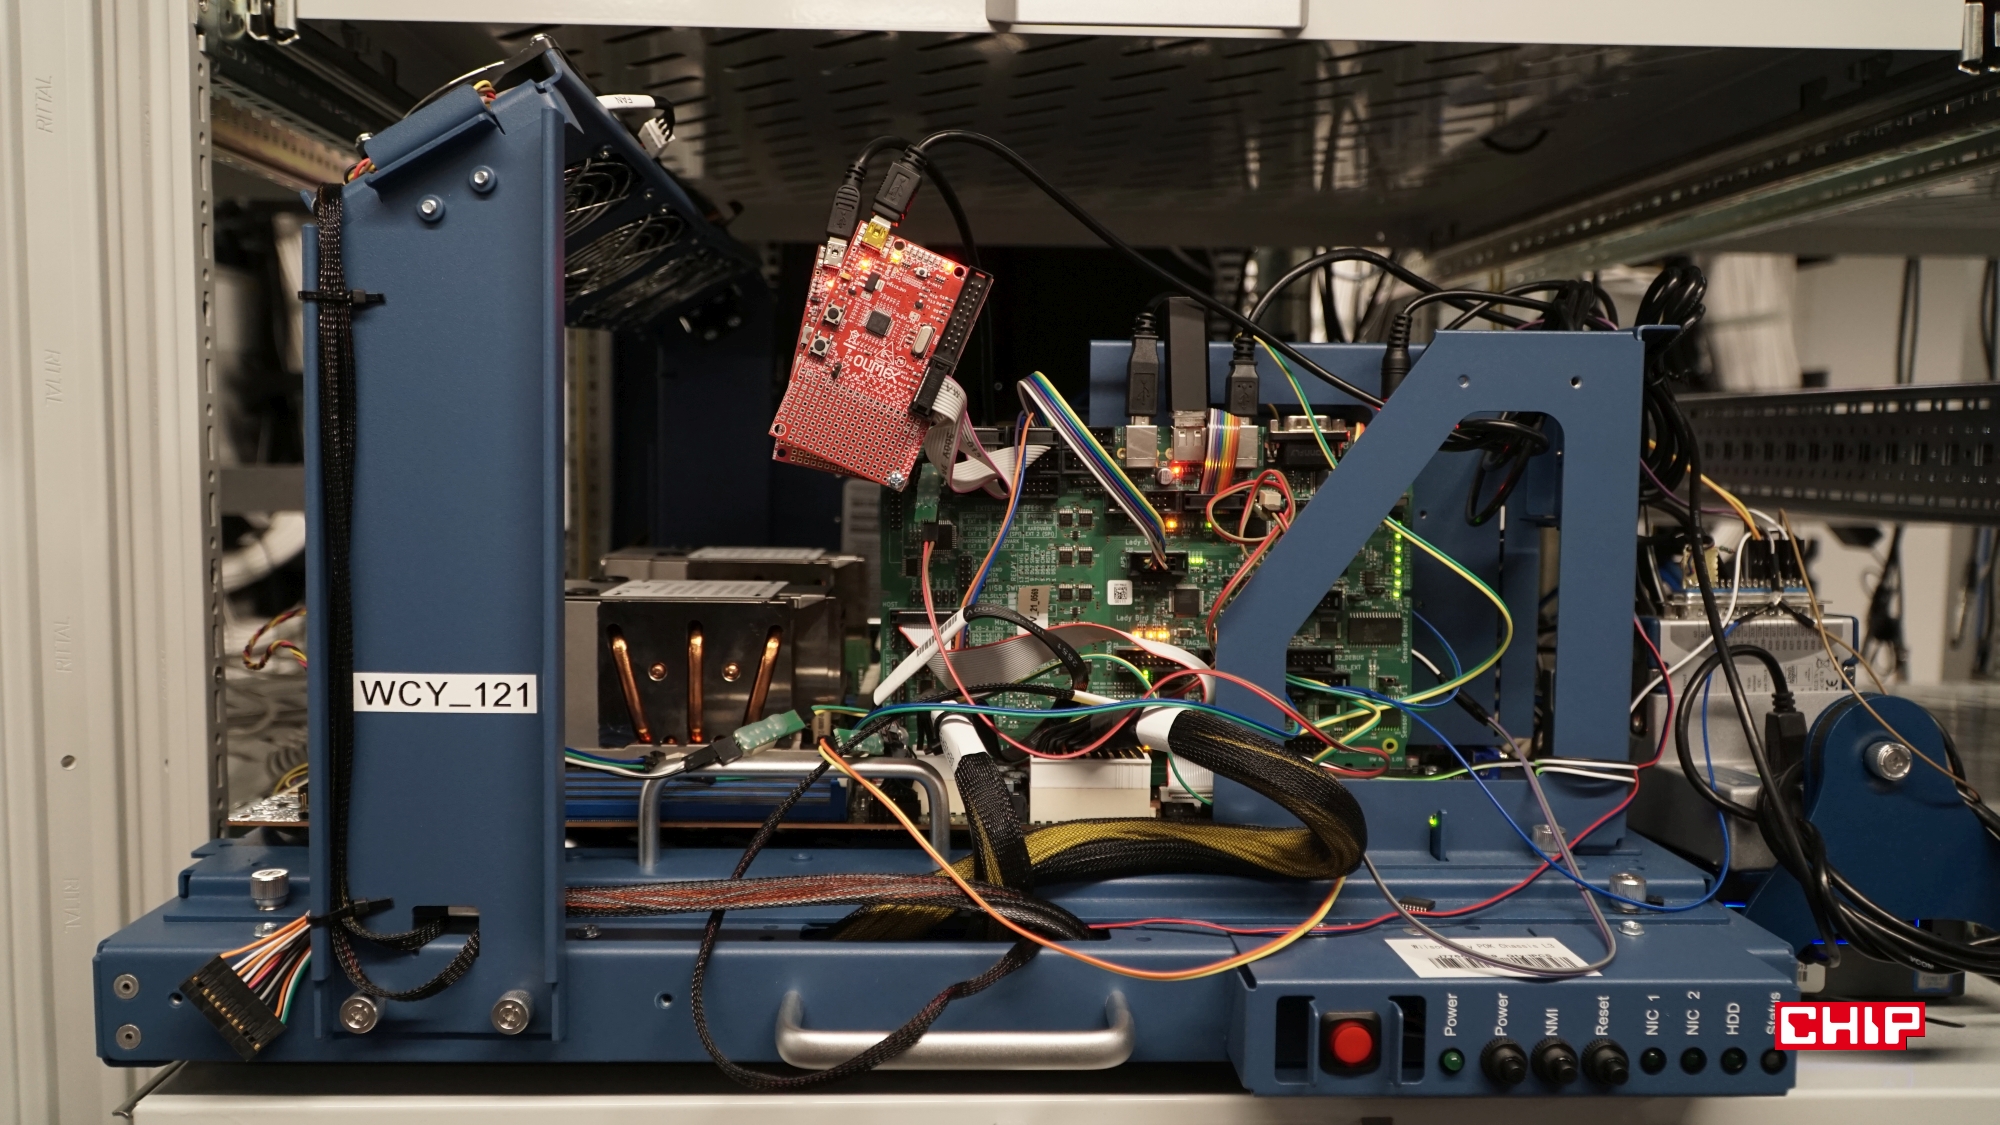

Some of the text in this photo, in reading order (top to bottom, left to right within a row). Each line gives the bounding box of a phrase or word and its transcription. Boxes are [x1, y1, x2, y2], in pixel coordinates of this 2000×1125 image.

[35, 75, 54, 134] RITTAL
[44, 349, 64, 408] RITTAL
[360, 680, 530, 709] WCY_121
[1444, 993, 1458, 1037] Power
[1494, 993, 1508, 1037] Power
[1545, 1008, 1558, 1036] NMI
[1595, 995, 1610, 1036] Reset
[1645, 1009, 1659, 1035] NIC
[1686, 991, 1700, 1035] NIC 2
[1726, 1002, 1740, 1035] HDD
